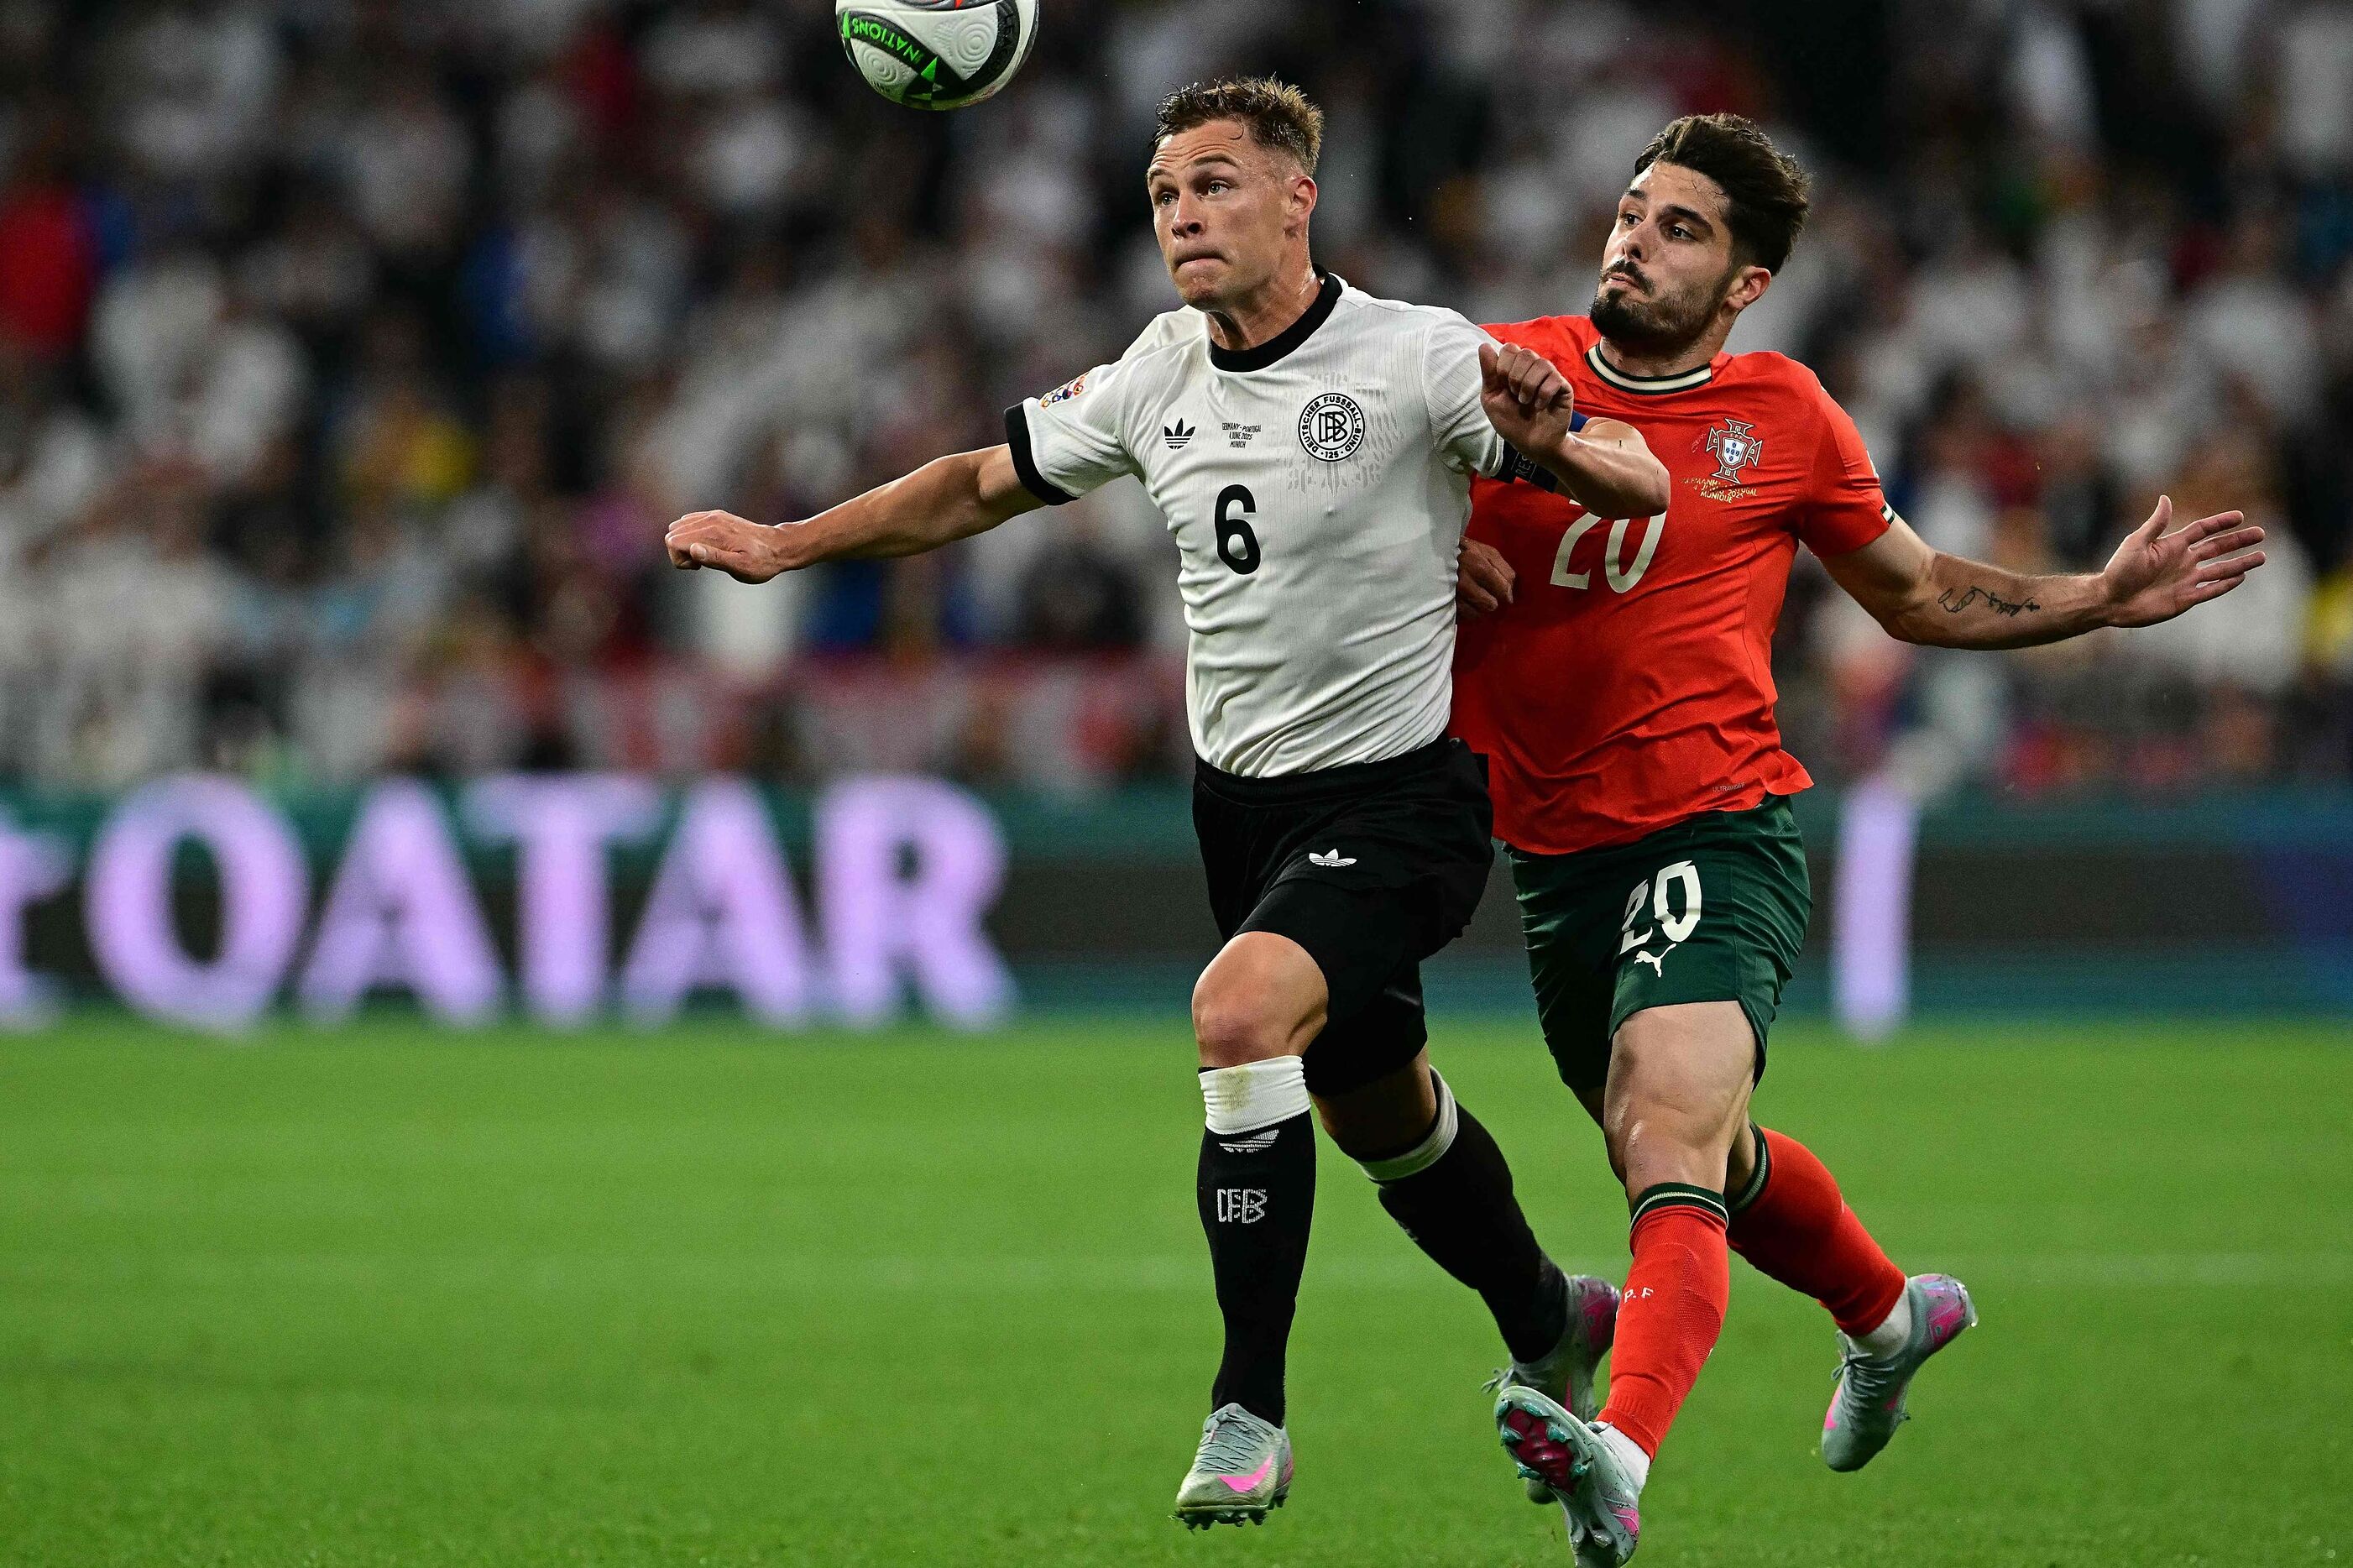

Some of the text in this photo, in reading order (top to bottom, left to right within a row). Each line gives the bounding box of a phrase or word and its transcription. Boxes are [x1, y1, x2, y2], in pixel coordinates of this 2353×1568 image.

[852, 18, 920, 61] NATIONS
[1241, 432, 1253, 441] 2025
[1301, 400, 1321, 453] DEUTSCHER
[1325, 451, 1340, 459] 125
[1681, 477, 1721, 487] ALEMANH
[1728, 489, 1744, 499] 2025
[1700, 491, 1733, 504] MUNIQUE
[1215, 484, 1261, 575] 6
[1550, 499, 1667, 593] 20
[1619, 860, 1702, 955] 20
